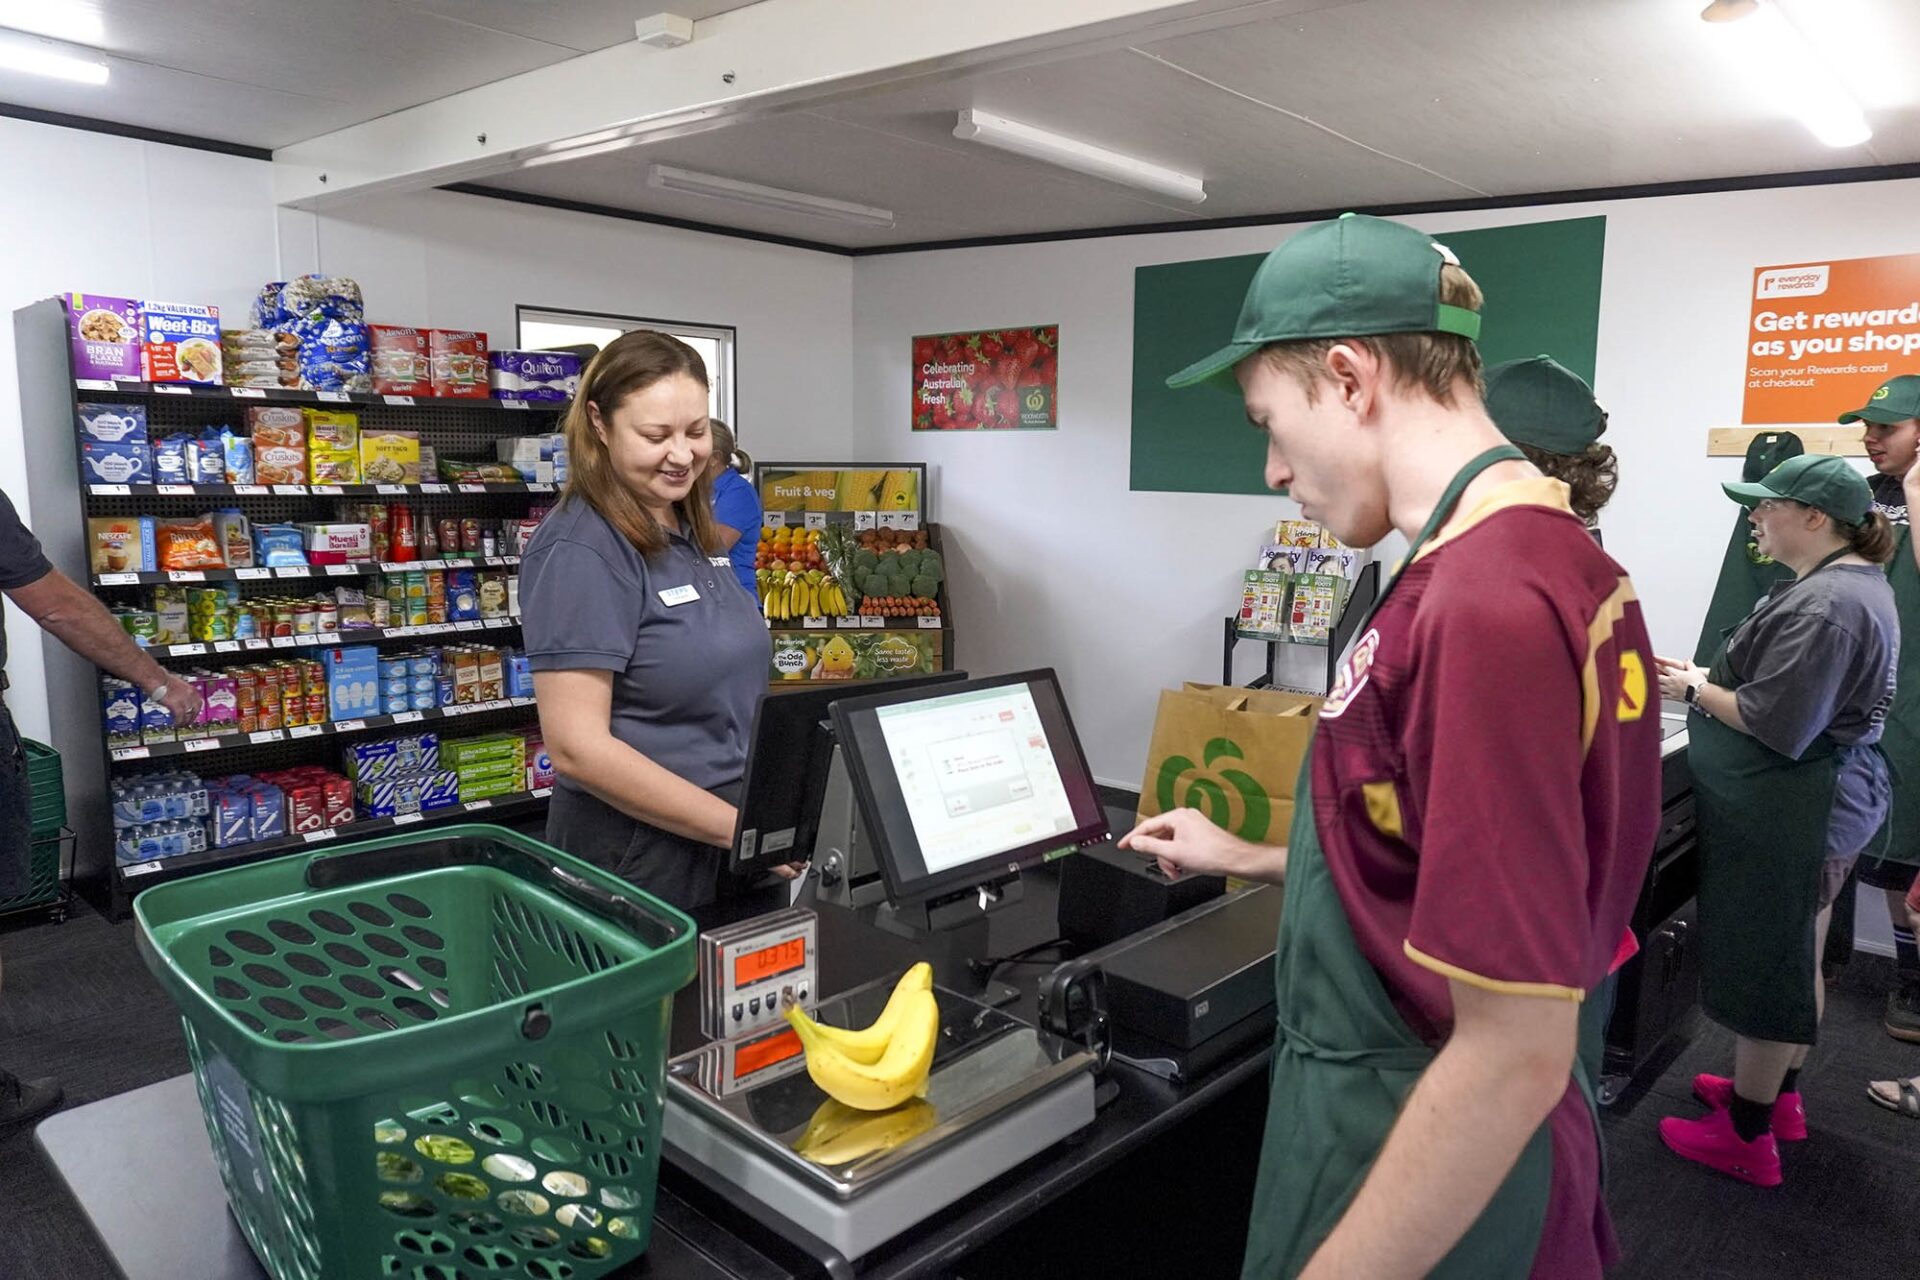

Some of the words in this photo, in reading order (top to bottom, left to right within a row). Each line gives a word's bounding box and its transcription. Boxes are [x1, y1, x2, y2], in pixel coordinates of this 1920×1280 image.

[1778, 273, 1821, 284] everyday
[1777, 281, 1816, 291] rewards
[166, 304, 188, 314] VALUE
[189, 306, 207, 315] PACK
[1754, 311, 1808, 332] Get
[1812, 302, 1920, 329] reward
[147, 315, 217, 336] Weet-Bix
[86, 345, 124, 357] BRAN
[1751, 339, 1785, 356] as
[1788, 337, 1843, 361] you
[521, 359, 563, 376] Quilton
[922, 362, 975, 375] Celebrating
[1749, 367, 1778, 377] Scan
[1780, 368, 1805, 378] your
[1807, 364, 1858, 375] Rewards
[1860, 363, 1888, 374] card
[922, 379, 967, 389] Australian
[1749, 380, 1760, 388] at
[1762, 378, 1815, 388] checkout
[922, 394, 946, 404] Fresh
[261, 413, 297, 422] Cruskits
[264, 452, 300, 461] Cruskits
[774, 486, 802, 497] Fruit
[803, 486, 812, 497] &
[814, 488, 836, 500] veg
[328, 535, 359, 543] Muesli
[1263, 550, 1301, 564] ety
[1310, 551, 1353, 566] bey
[787, 653, 803, 661] Odd
